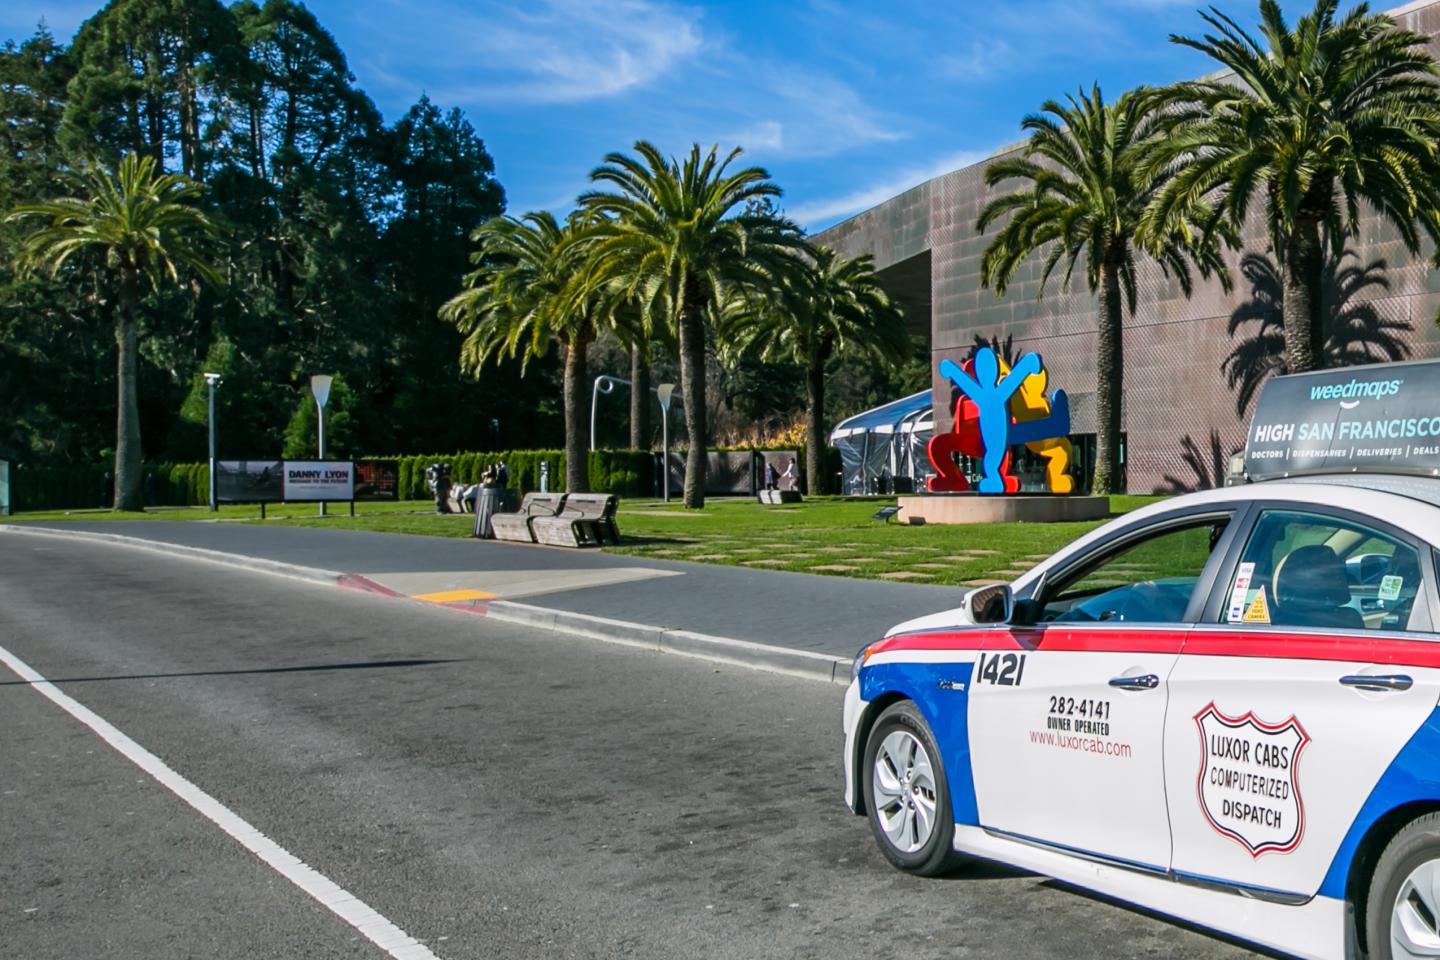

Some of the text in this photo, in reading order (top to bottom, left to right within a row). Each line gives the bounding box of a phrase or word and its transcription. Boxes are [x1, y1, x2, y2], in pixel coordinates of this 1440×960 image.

[1310, 379, 1400, 400] weedmaps
[1254, 423, 1295, 443] HIGH
[1297, 421, 1335, 441] SAN
[1251, 450, 1284, 459] DOCTORS
[1356, 447, 1403, 457] DELIVERIES
[1413, 445, 1440, 455] DEALS
[289, 470, 349, 479] DANNY LYON
[977, 653, 1026, 686] 1421
[1047, 716, 1109, 736] OWNER OPERATED
[1029, 730, 1132, 758] www.luxorcab.com
[1211, 734, 1289, 769] LUXOR CABS
[1210, 766, 1289, 800] COMPUTERIZED
[1222, 799, 1282, 829] DISPATCH
